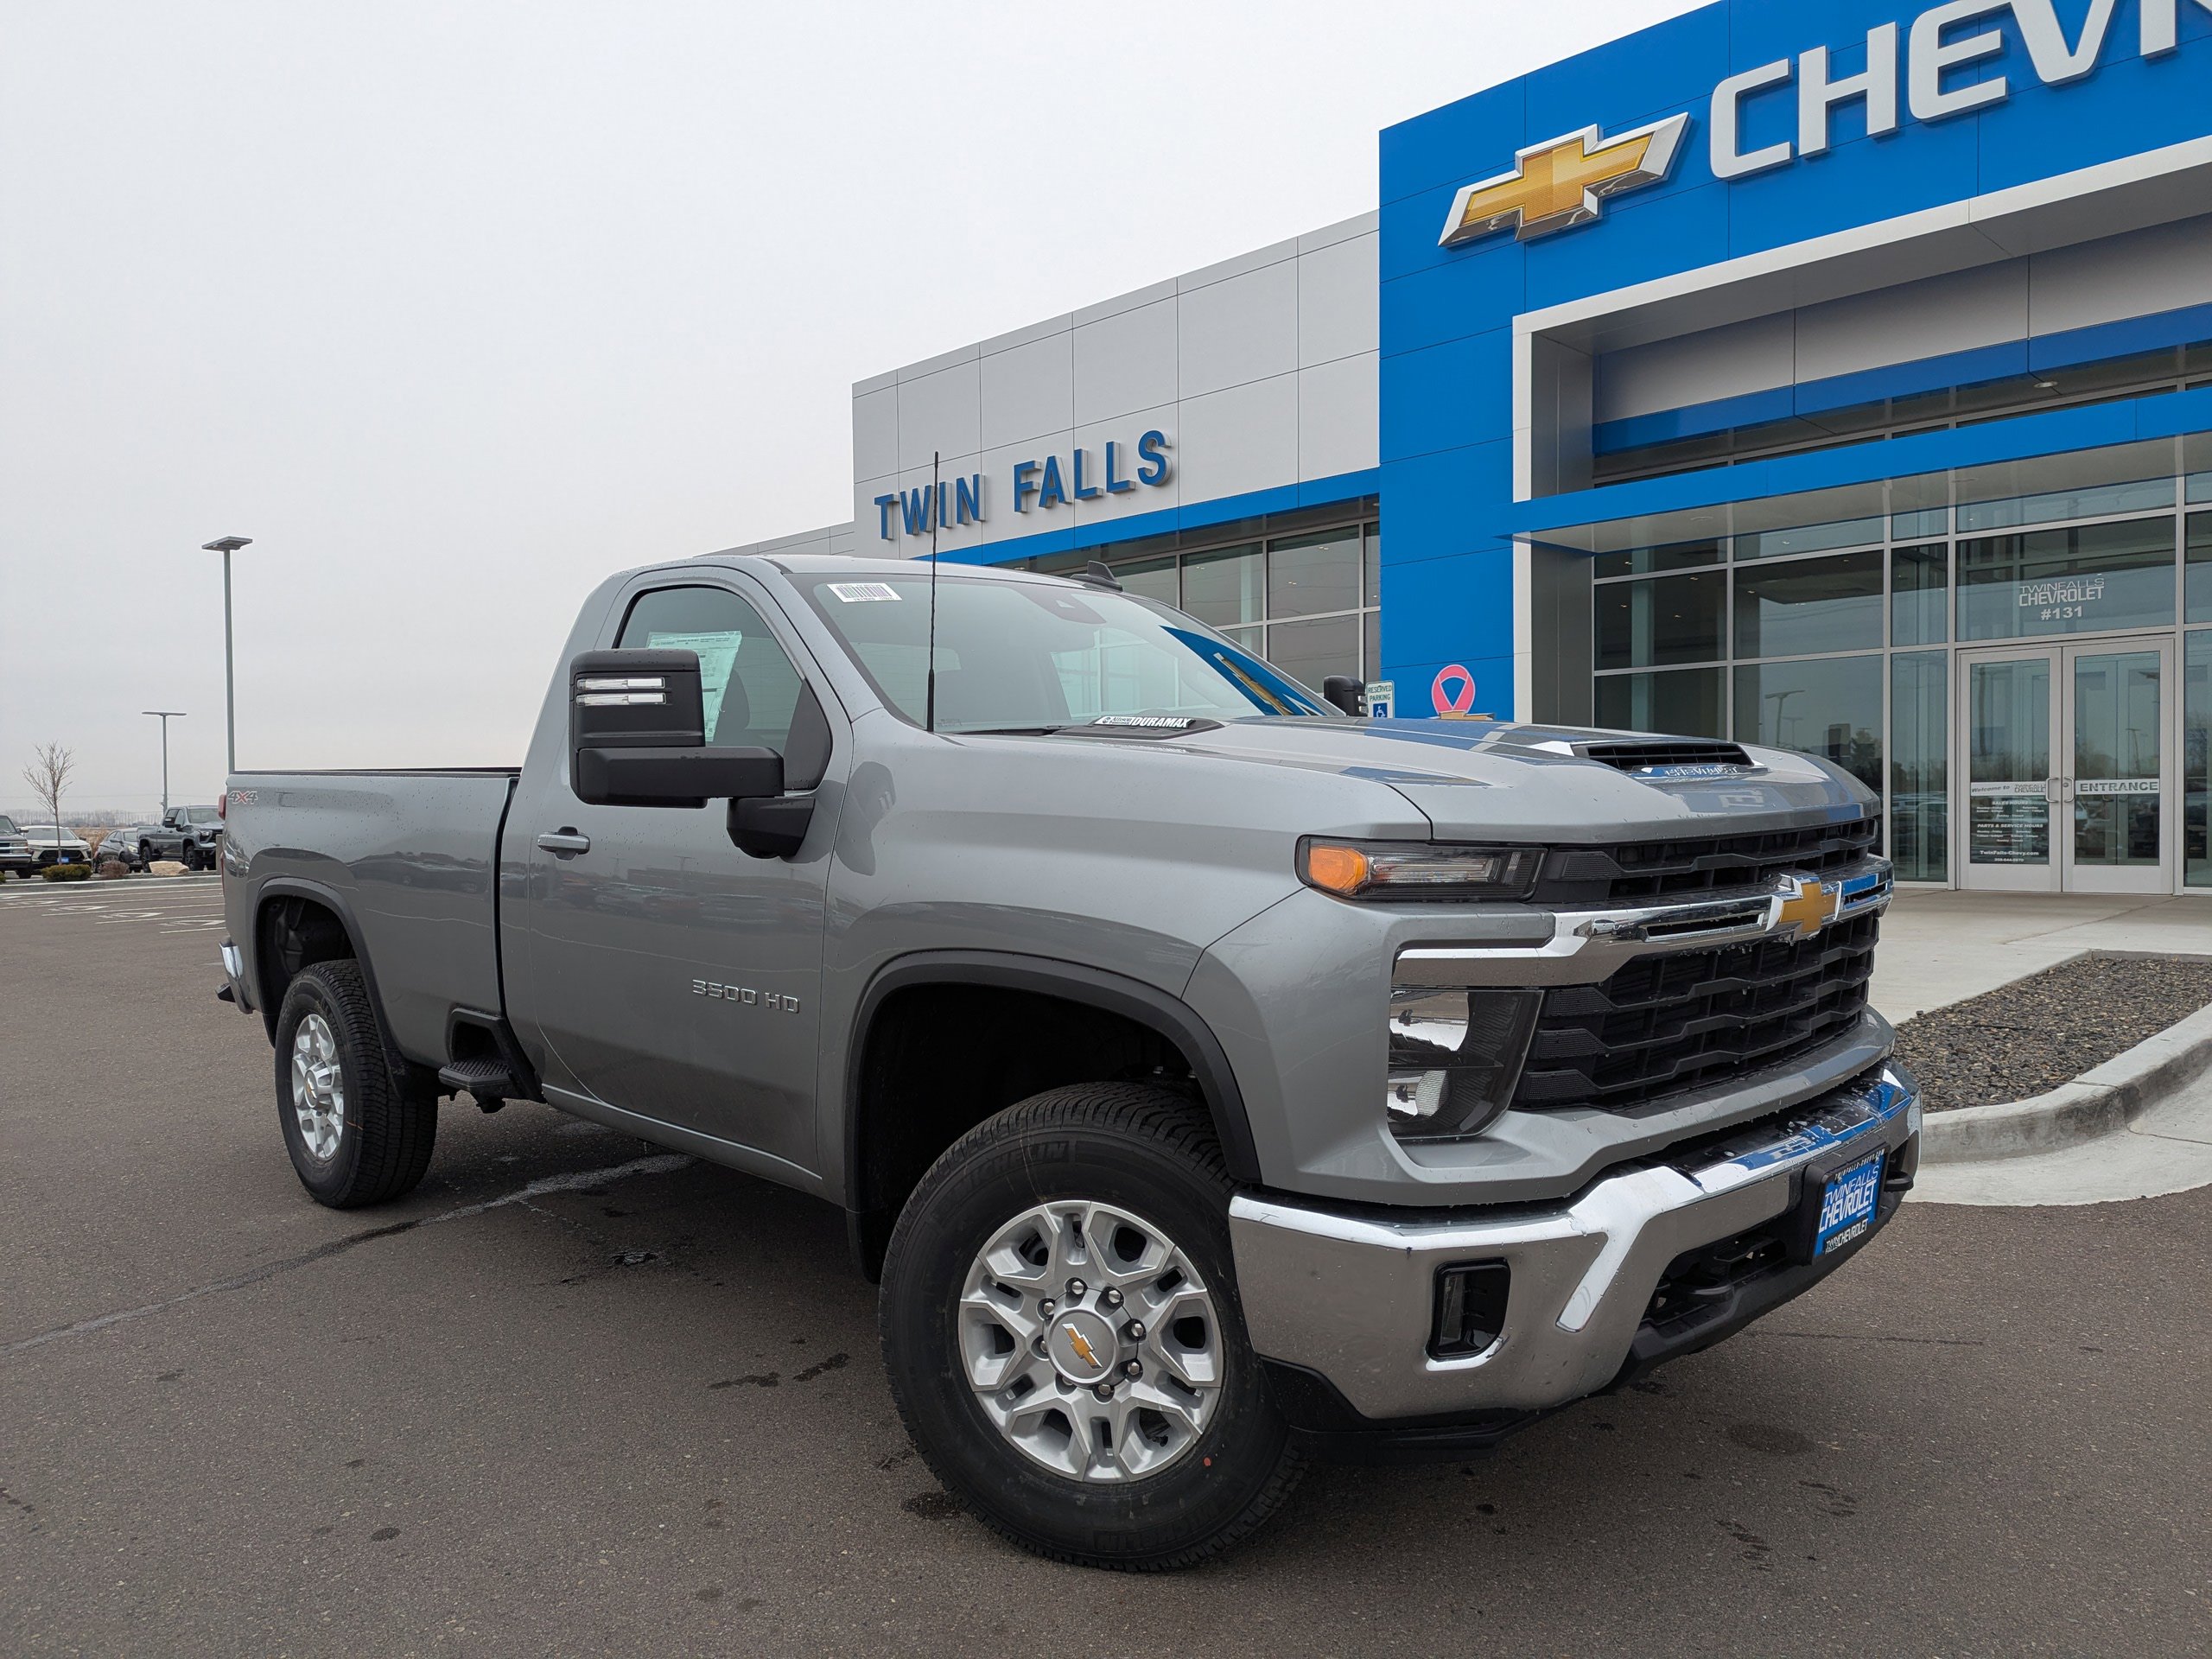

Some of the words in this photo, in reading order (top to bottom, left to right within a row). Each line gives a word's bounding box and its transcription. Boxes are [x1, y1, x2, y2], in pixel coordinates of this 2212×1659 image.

[874, 474, 986, 540] TWIN
[1014, 429, 1173, 513] FALLS
[2019, 577, 2104, 594] TWINFALLS
[2018, 586, 2105, 606] CHEVROLET
[2040, 606, 2082, 620] #131
[1131, 716, 1192, 728] DURAMAX
[1664, 766, 1738, 777] CHEVROLET
[2080, 781, 2158, 791] ENTRANCE
[692, 979, 758, 1006] 3500
[765, 992, 800, 1014] HD
[1824, 1165, 1879, 1207] TWINFALLS
[1819, 1179, 1878, 1234] CHEVROLET
[1838, 1218, 1868, 1246] CHEVROLET
